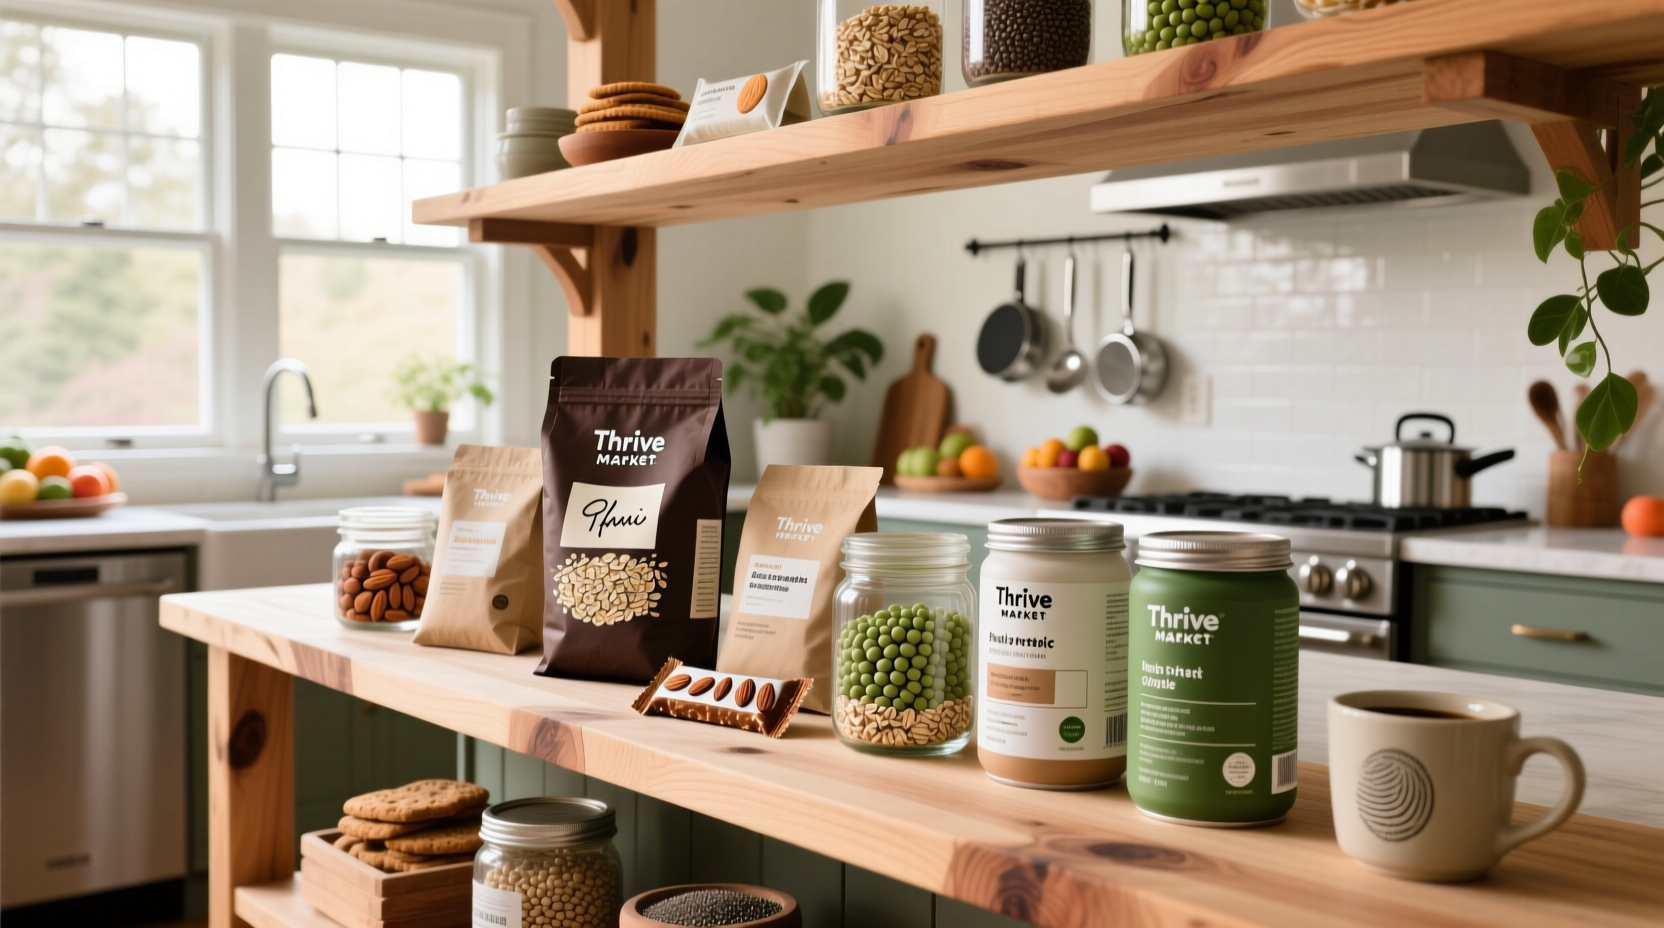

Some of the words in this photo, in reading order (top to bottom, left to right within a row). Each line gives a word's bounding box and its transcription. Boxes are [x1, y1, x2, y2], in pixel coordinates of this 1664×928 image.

[594, 429, 665, 452] Thrive
[777, 516, 823, 534] Thrive
[996, 586, 1053, 609] Thrive
[1001, 609, 1047, 621] MARKET
[1147, 604, 1220, 631] Thrive
[1155, 630, 1211, 645] MARKET
